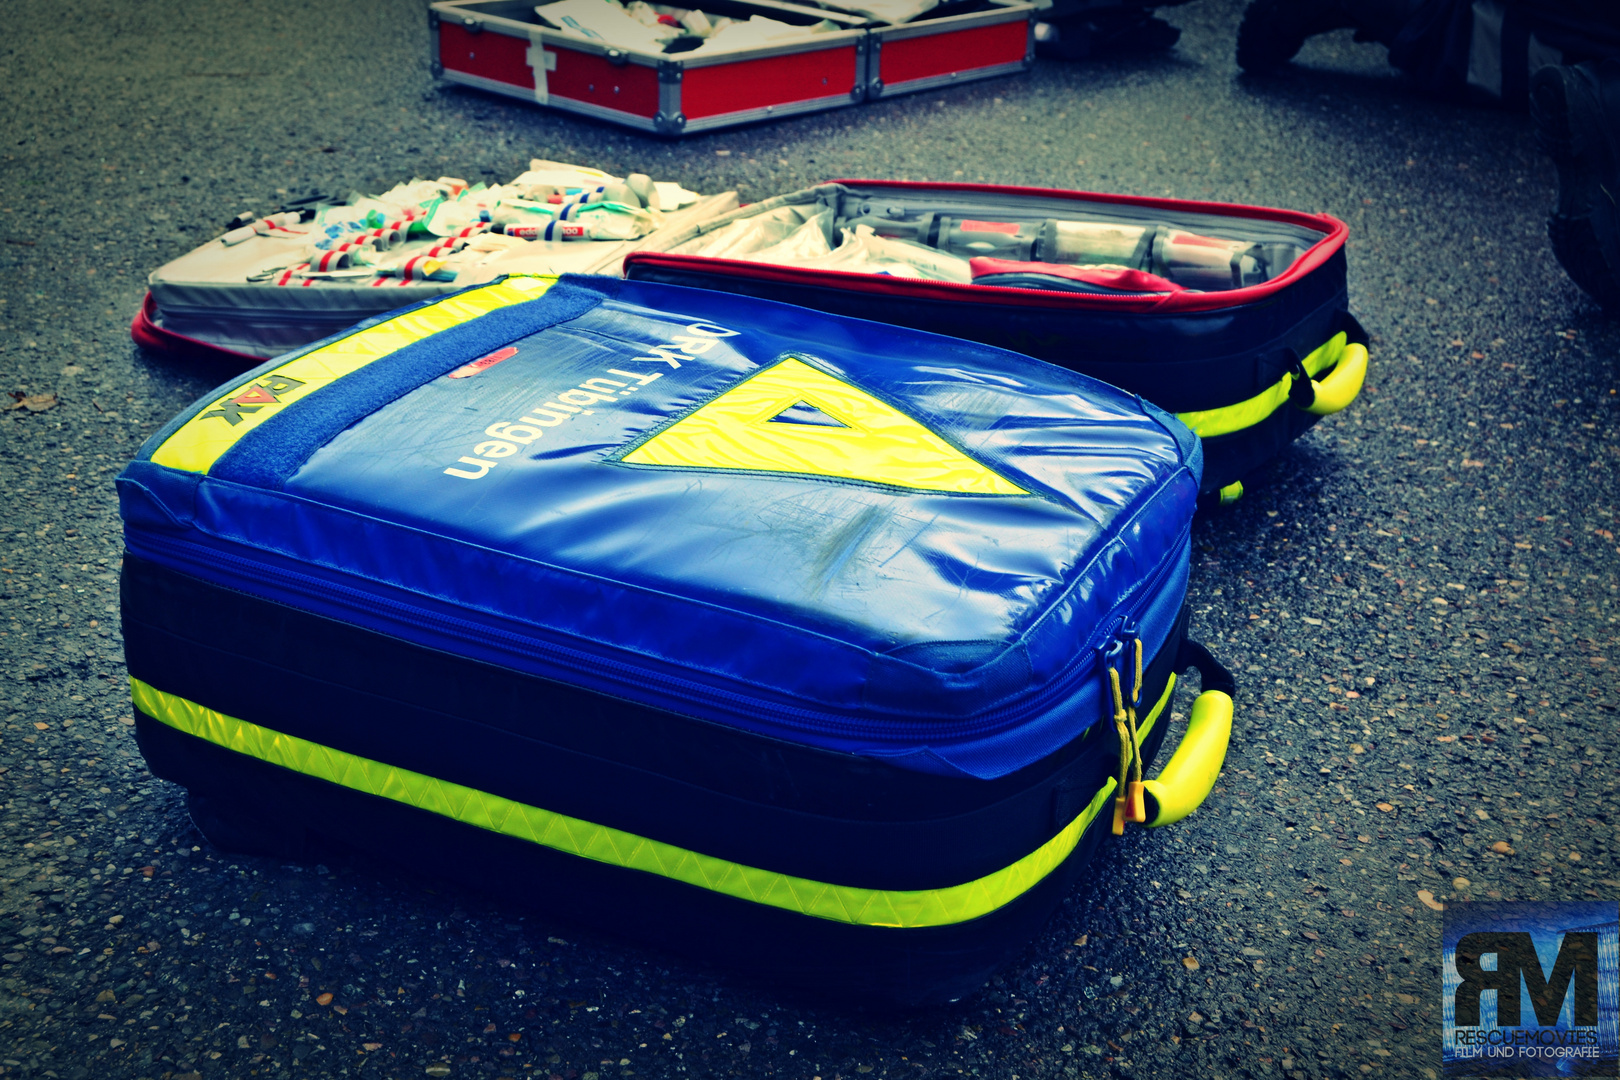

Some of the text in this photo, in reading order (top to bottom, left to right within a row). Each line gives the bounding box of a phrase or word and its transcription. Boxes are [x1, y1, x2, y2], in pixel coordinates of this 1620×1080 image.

[199, 374, 307, 426] PAX
[443, 322, 741, 480] DRK Tübingen
